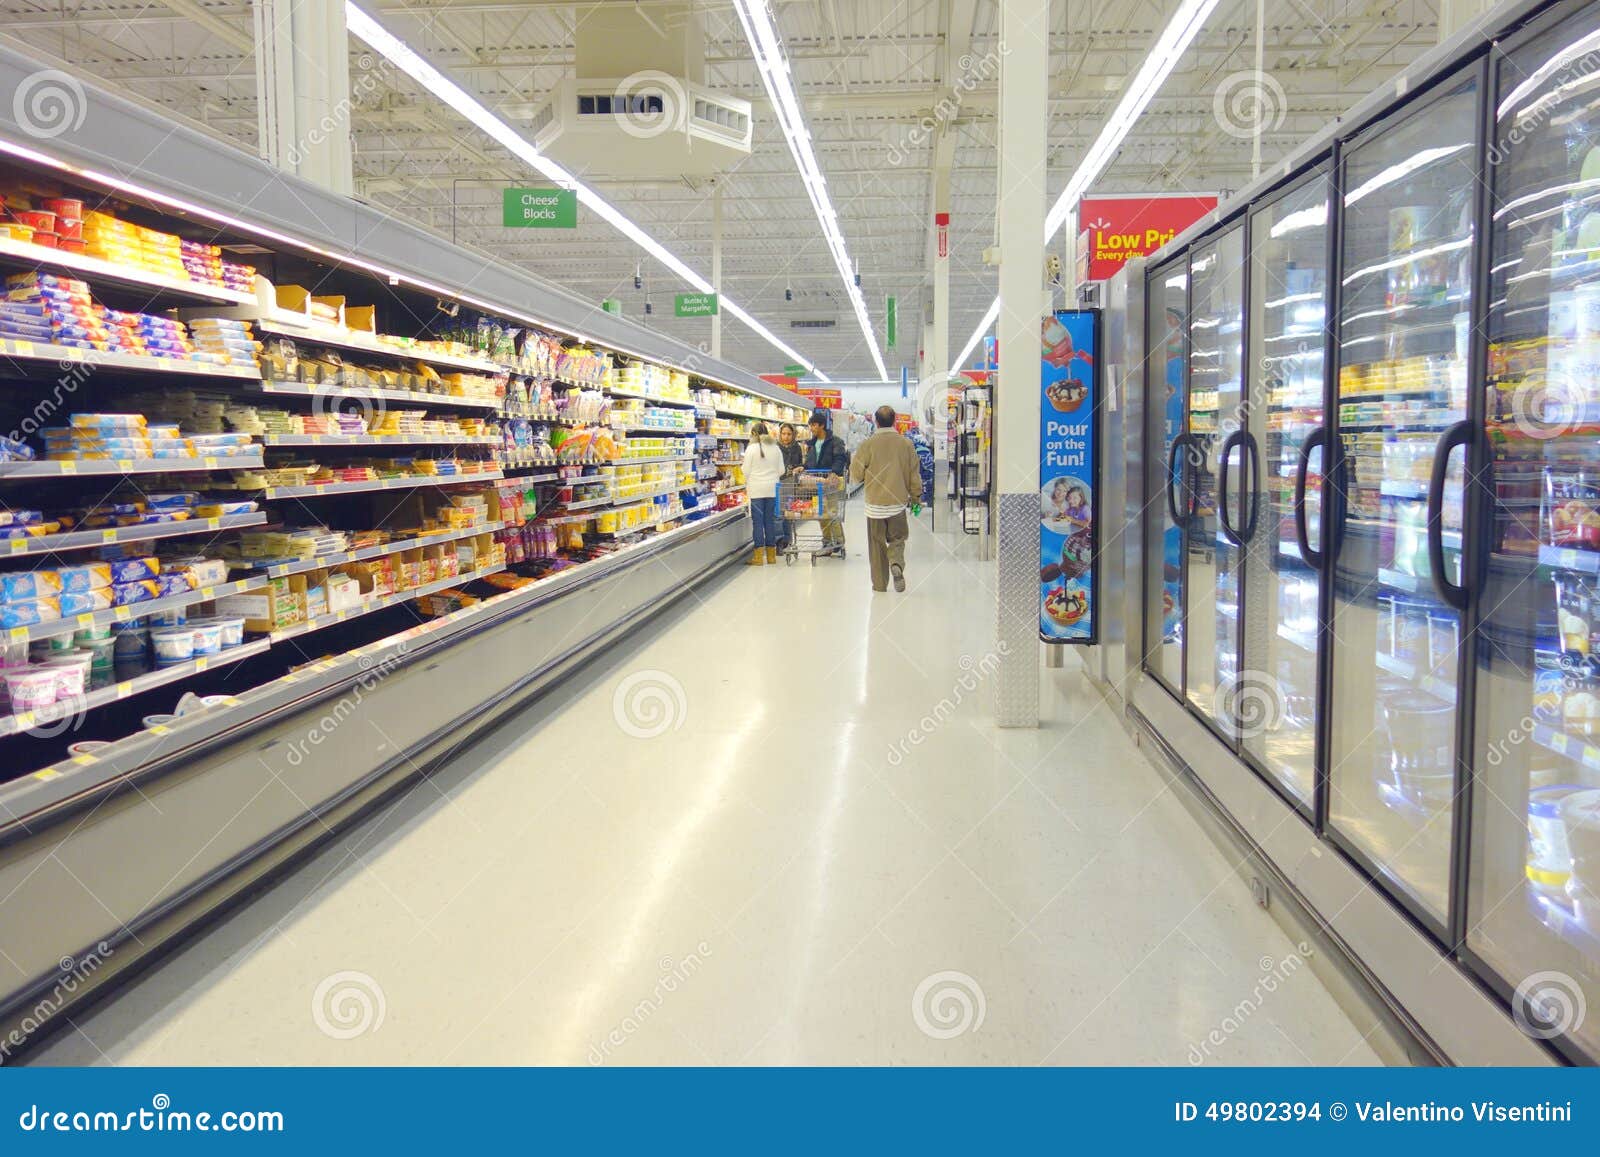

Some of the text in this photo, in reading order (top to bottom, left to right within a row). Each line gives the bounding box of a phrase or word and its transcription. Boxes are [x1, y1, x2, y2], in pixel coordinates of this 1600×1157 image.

[521, 194, 559, 206] Cheese
[524, 208, 556, 219] Blocks
[1096, 231, 1141, 249] Low
[1096, 250, 1124, 262] Every
[1047, 421, 1089, 436] Pour
[1046, 438, 1086, 449] on the
[1046, 451, 1085, 466] Fun!
